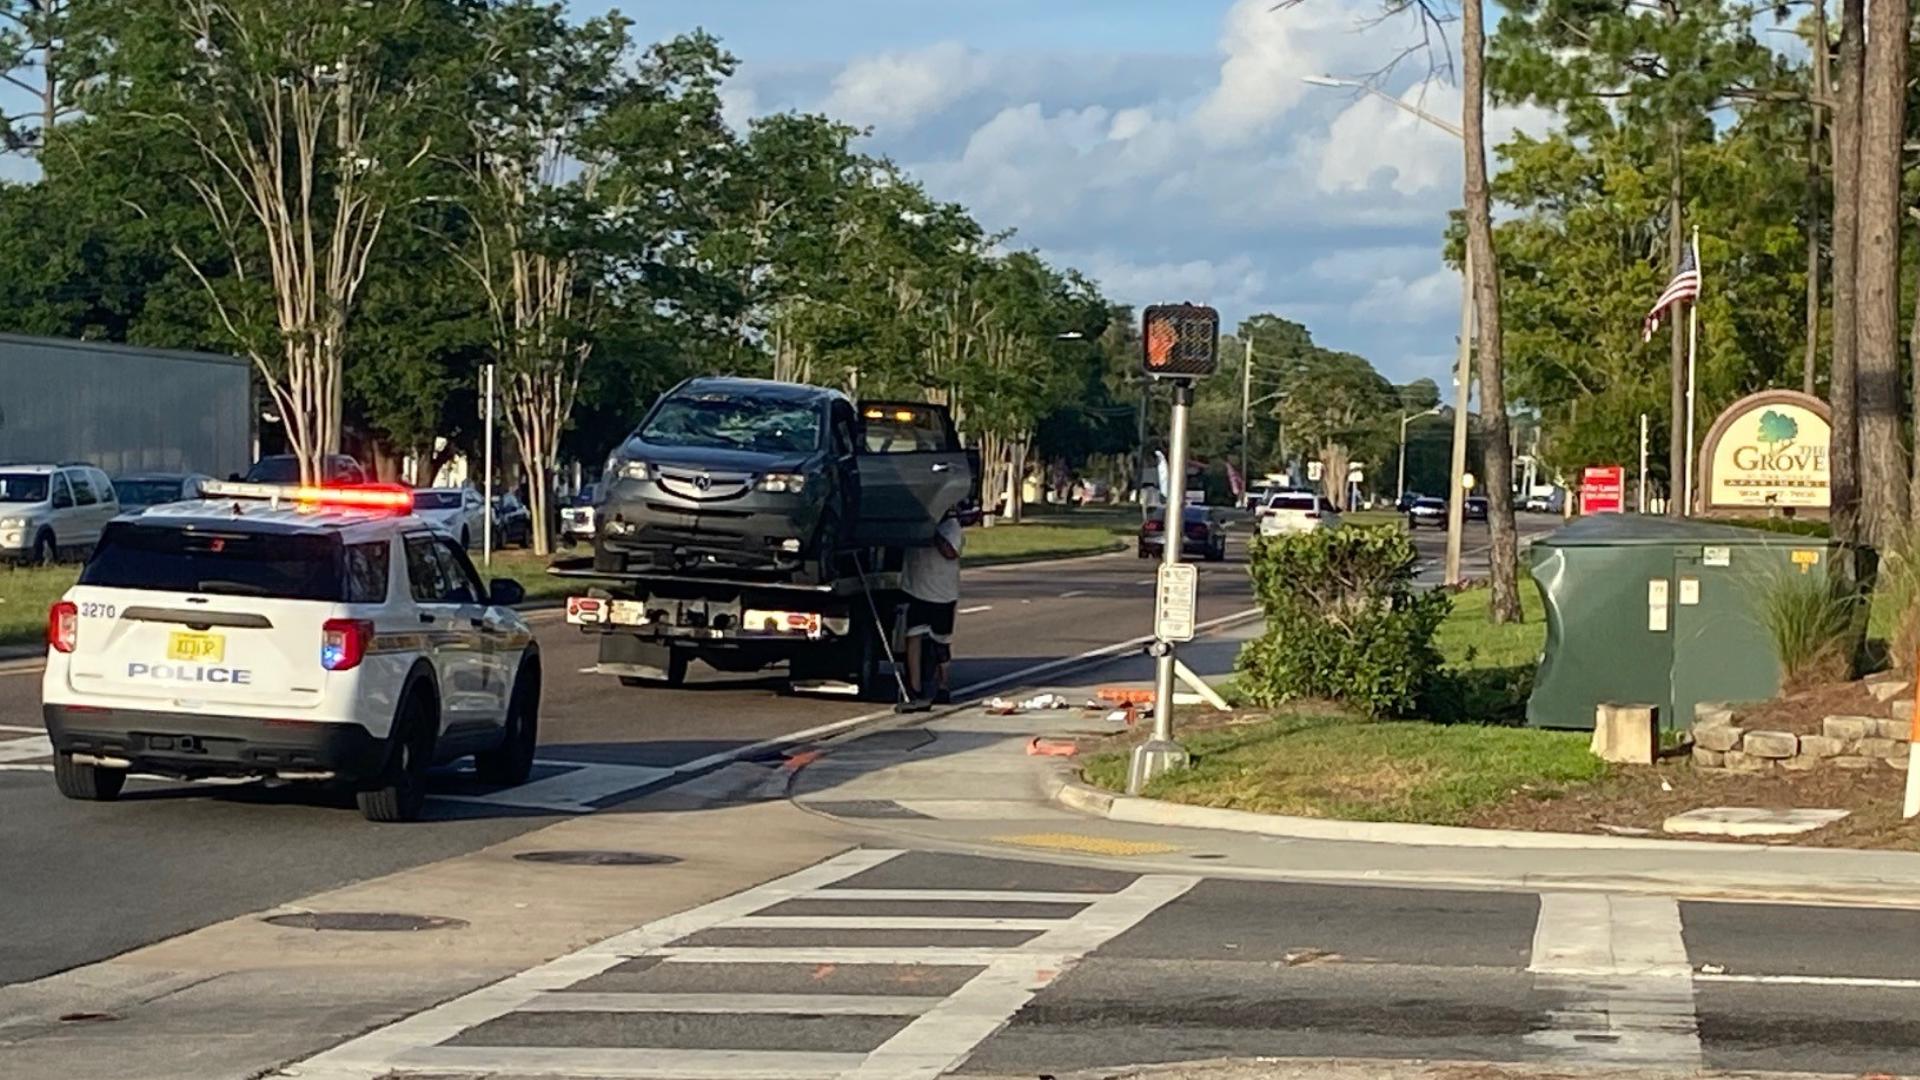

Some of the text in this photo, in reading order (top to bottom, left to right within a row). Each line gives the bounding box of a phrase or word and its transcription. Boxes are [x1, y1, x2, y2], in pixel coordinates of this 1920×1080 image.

[1733, 445, 1826, 472] GROVE
[1799, 445, 1826, 457] THE
[81, 602, 115, 618] 3270
[128, 662, 252, 685] POLICE
